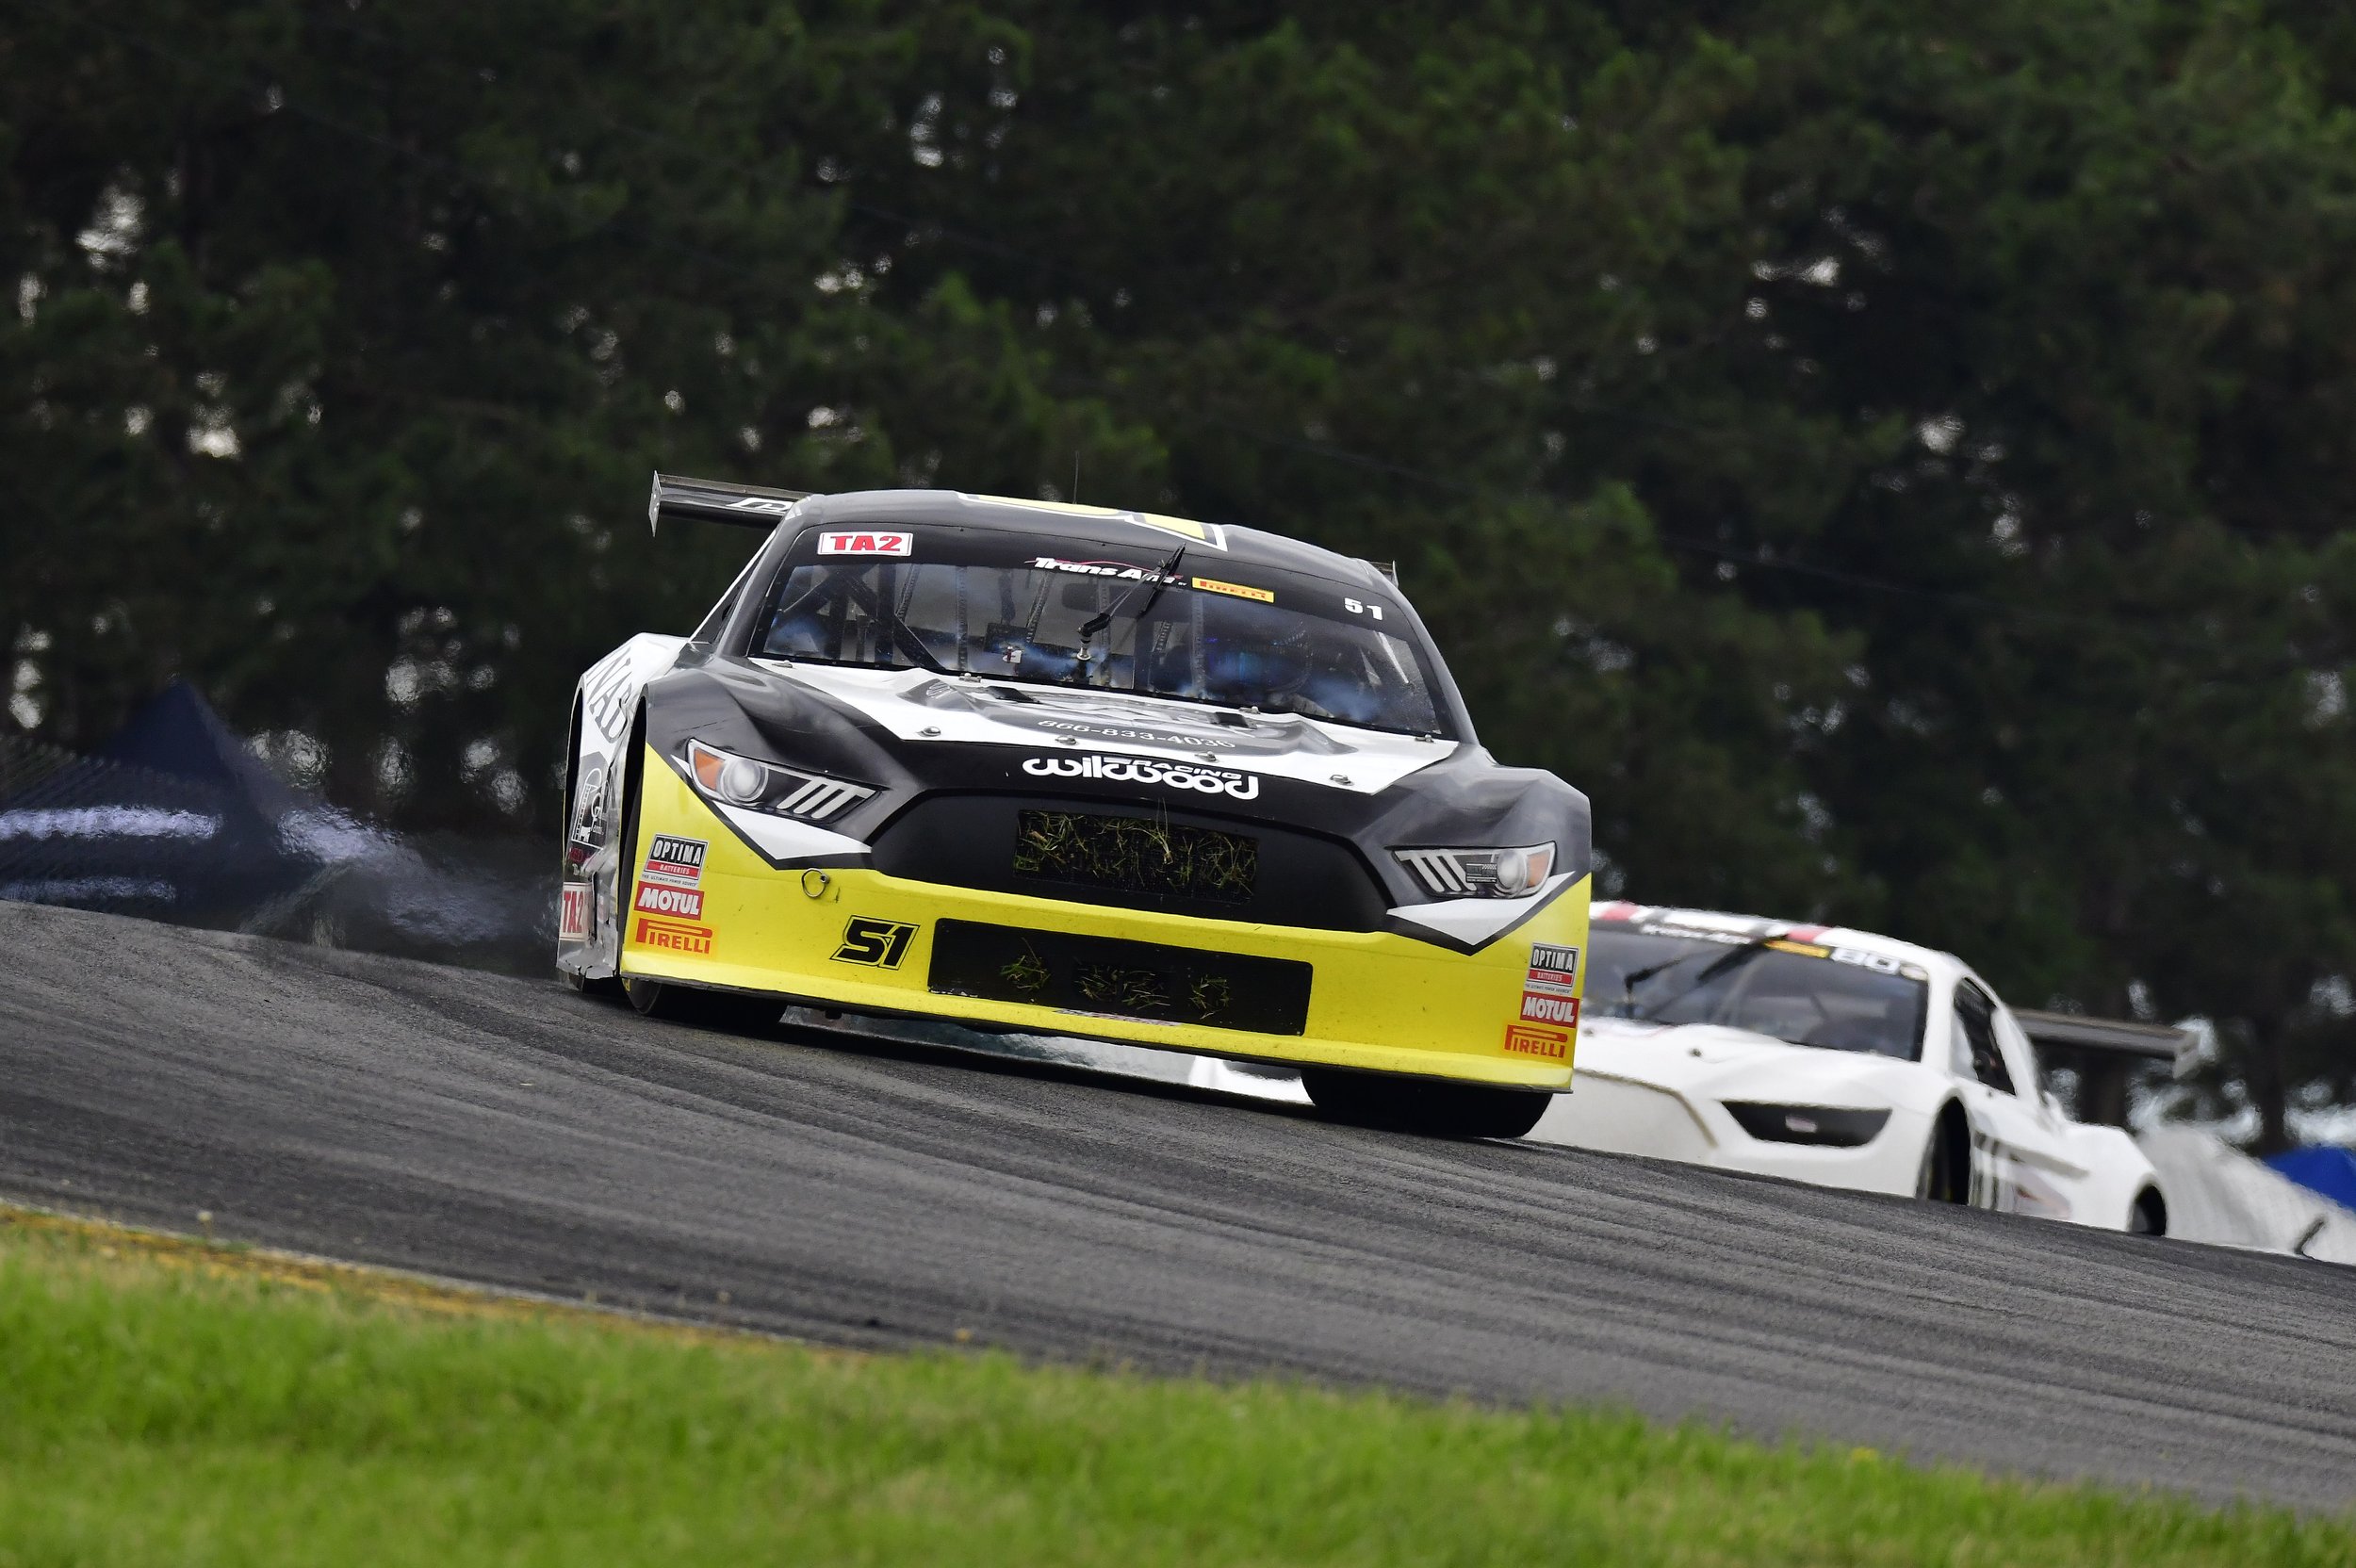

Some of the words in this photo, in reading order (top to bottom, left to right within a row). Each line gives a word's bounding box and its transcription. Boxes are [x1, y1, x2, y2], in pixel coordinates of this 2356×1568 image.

[830, 535, 902, 551] TA2
[1034, 557, 1118, 576] Trans
[1344, 597, 1383, 621] 51
[1022, 756, 1259, 800] wilwood
[1131, 759, 1243, 780] RACING
[652, 840, 702, 865] OPTIMA
[659, 864, 690, 875] BATTERIES
[563, 890, 584, 934] TA2
[638, 887, 699, 915] MOTUL
[635, 918, 713, 955] PIRELLI
[829, 915, 921, 972] 51
[1532, 948, 1574, 972] OPTIMA
[1522, 996, 1576, 1023] MOTUL
[1504, 1024, 1568, 1058] PIRELLI
